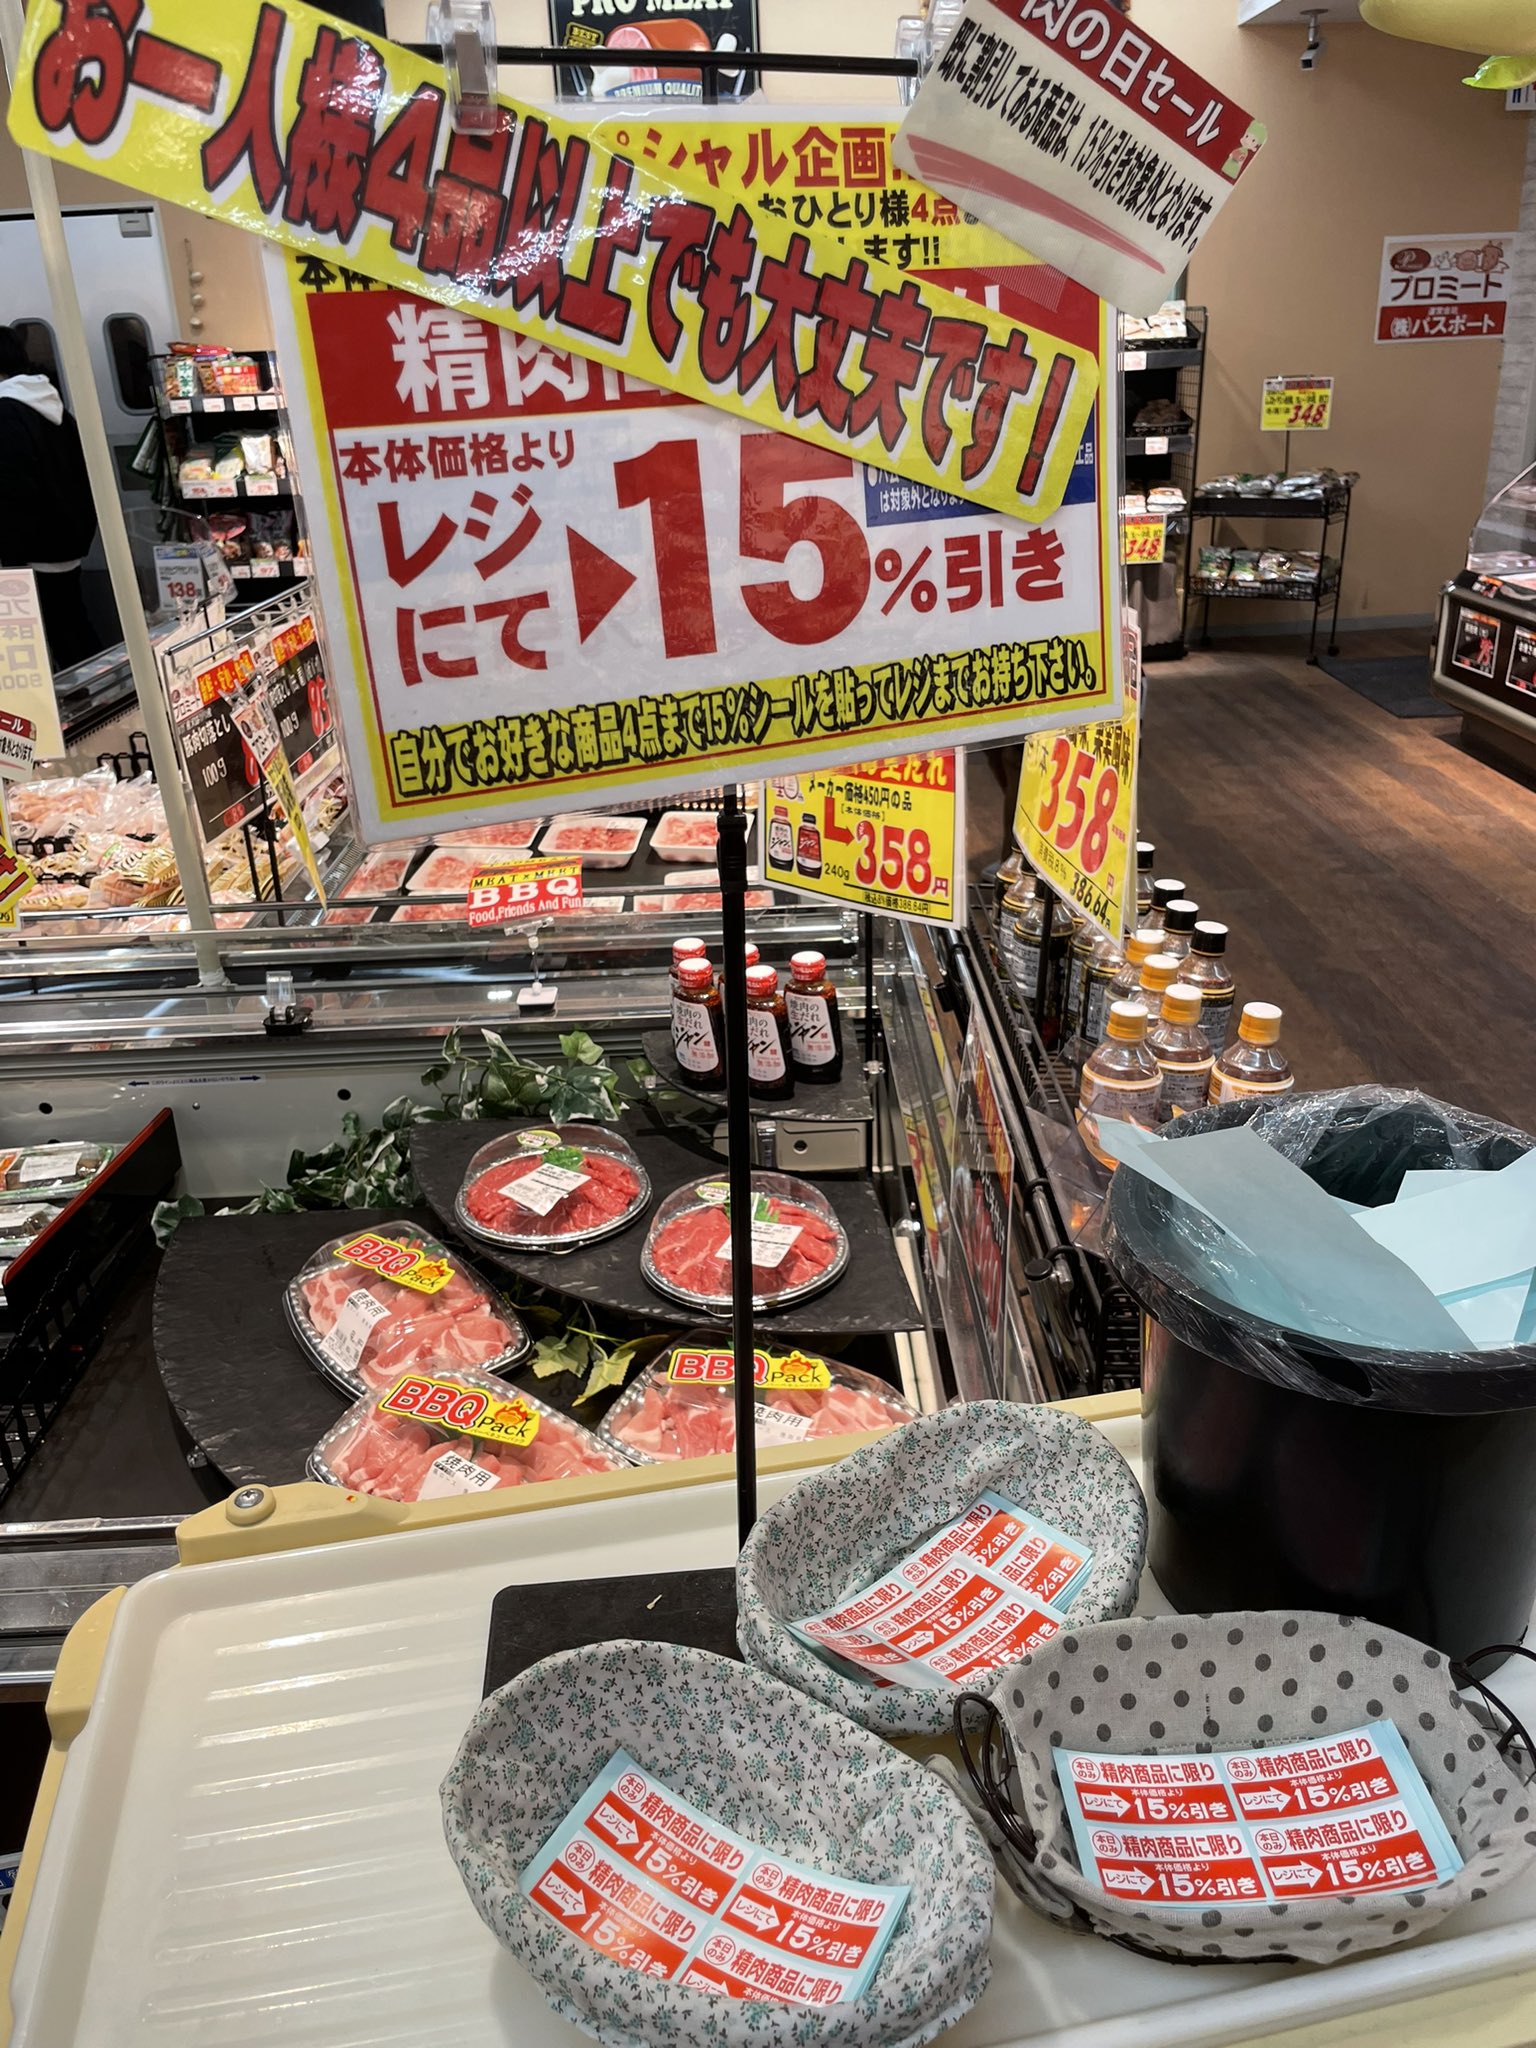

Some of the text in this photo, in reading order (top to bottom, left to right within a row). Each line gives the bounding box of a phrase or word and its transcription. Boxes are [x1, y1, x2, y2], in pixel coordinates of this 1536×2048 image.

[572, 27, 600, 42] BEST
[614, 81, 702, 98] PREMIUM QUALIT
[338, 429, 576, 487] 本体価格より
[378, 481, 543, 588] レジ
[167, 581, 196, 599] 138
[396, 590, 552, 687] にて
[824, 862, 850, 880] 240g
[469, 877, 580, 910] BBQ
[538, 897, 560, 912] And
[561, 895, 583, 909] Fun
[337, 1235, 441, 1288] BBQ Pack
[771, 1368, 822, 1383] Pack
[384, 1377, 531, 1439] BBQ Pack
[440, 1454, 493, 1488] 焼肉用
[919, 1504, 992, 1568] 精肉商品に限り
[999, 1537, 1048, 1581] 品に限り
[822, 1583, 903, 1632] 精肉商品に限り
[890, 1568, 968, 1628] 精肉商品に限り
[924, 1599, 959, 1625] 本体価格より
[932, 1587, 998, 1637] 15%引き
[903, 1631, 930, 1649] レジにて
[950, 1603, 1025, 1663] 精肉商品に限り
[1076, 1761, 1095, 1770] 本日
[1233, 1761, 1252, 1771] 本日
[1257, 1737, 1374, 1778] 精肉商品に限り
[1077, 1770, 1096, 1778] のみ
[1100, 1762, 1215, 1783] 精肉商品に限り
[1234, 1770, 1253, 1779] のみ
[1289, 1771, 1343, 1788] 本体価格より
[619, 1784, 639, 1802] のみ
[624, 1775, 644, 1792] 本日
[1131, 1788, 1184, 1797] 本体価格より
[1293, 1777, 1392, 1810] 15%引き
[1084, 1797, 1124, 1809] レジにて
[1134, 1798, 1230, 1821] 15%引き
[1243, 1792, 1282, 1806] レジにて
[597, 1807, 633, 1840] レジにて
[639, 1791, 745, 1872] 精肉商品に限り
[1286, 1809, 1409, 1850] 精肉商品に限り
[650, 1830, 698, 1865] 本体価格より
[1096, 1835, 1115, 1844] 本日
[1097, 1842, 1117, 1852] のみ
[1122, 1835, 1243, 1858] 精肉商品に限り
[1259, 1833, 1278, 1842] 本日
[1260, 1842, 1281, 1851] のみ
[568, 1852, 587, 1869] のみ
[573, 1843, 592, 1858] 本日
[1321, 1844, 1377, 1862] 本体価格より
[633, 1839, 719, 1908] 15%引き
[761, 1866, 781, 1878] 本日
[1106, 1871, 1147, 1885] レジにて
[1155, 1863, 1210, 1873] 本体価格より
[1272, 1867, 1315, 1880] レジにて
[1326, 1850, 1428, 1887] 15%引き
[755, 1875, 776, 1889] のみ
[1157, 1875, 1257, 1897] 15%引き
[544, 1876, 583, 1911] レジにて
[587, 1860, 698, 1943] 精肉商品に限り
[778, 1875, 885, 1923] 精肉商品に限り
[734, 1899, 775, 1924] レジにて
[790, 1911, 841, 1932] 本体価格より
[580, 1910, 669, 1978] 15%引き
[713, 1938, 733, 1953] 本日
[776, 1919, 864, 1961] 15%引き
[707, 1947, 728, 1963] のみ
[730, 1949, 844, 2005] 精肉商品に限り
